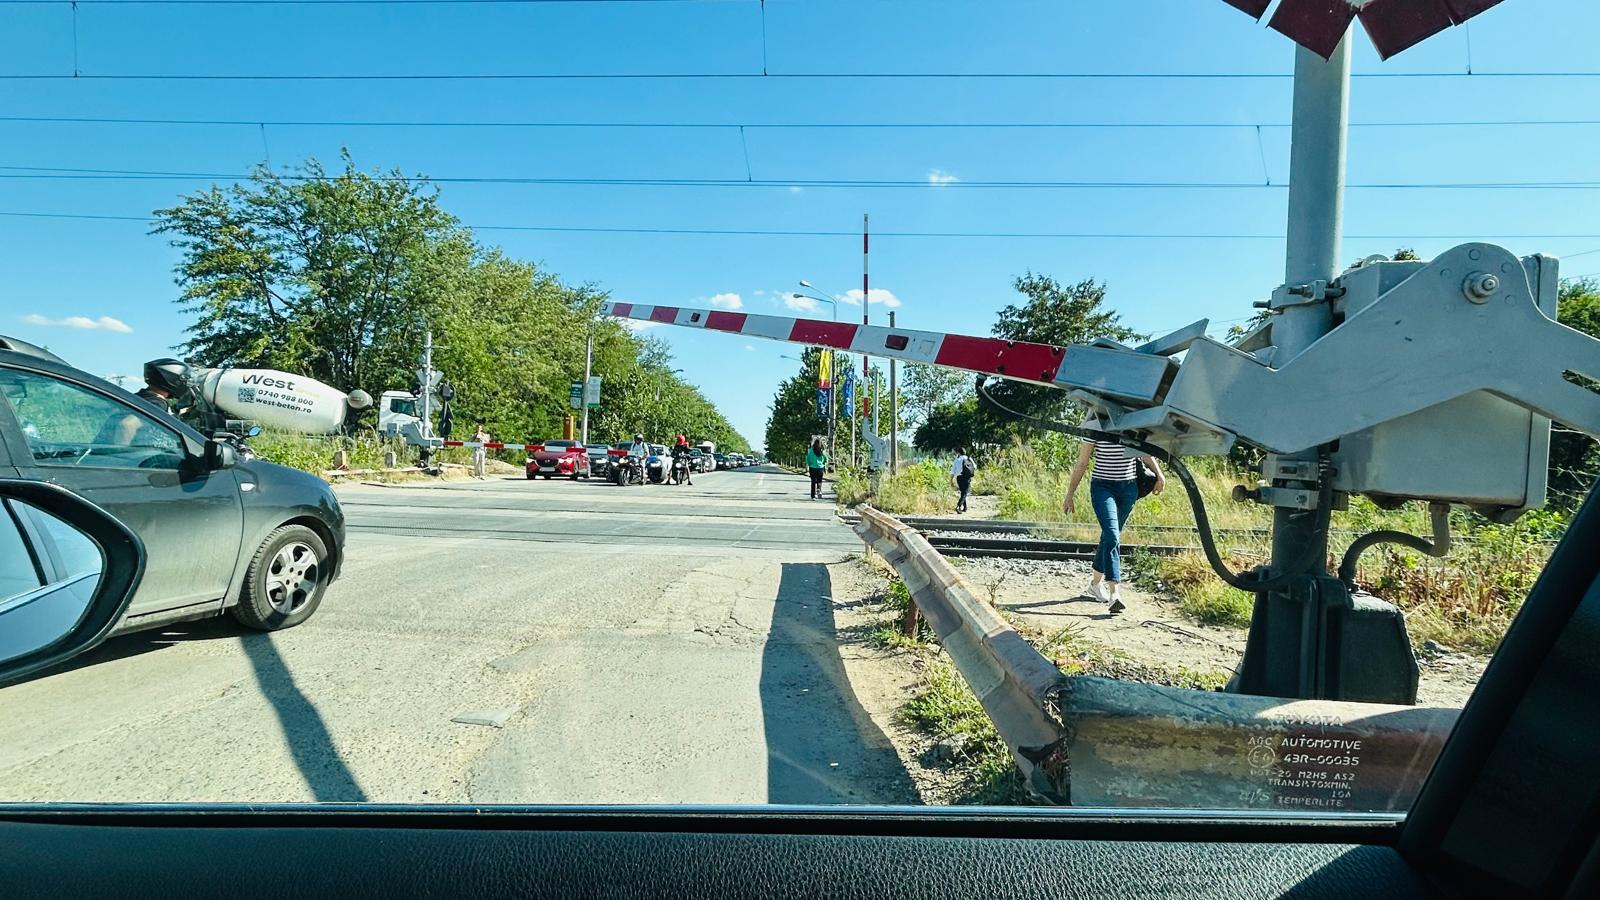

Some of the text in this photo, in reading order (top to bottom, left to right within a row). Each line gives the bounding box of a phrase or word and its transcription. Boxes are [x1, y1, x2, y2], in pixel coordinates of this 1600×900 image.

[242, 374, 296, 391] West
[258, 389, 279, 399] 0740
[256, 397, 312, 414] west-beton.ro
[1248, 736, 1362, 751] AGC AUTOMOTIVE
[1284, 753, 1360, 766] 43R-00035
[1334, 773, 1356, 781] AS2
[1277, 795, 1344, 808] TEMPERLITE
